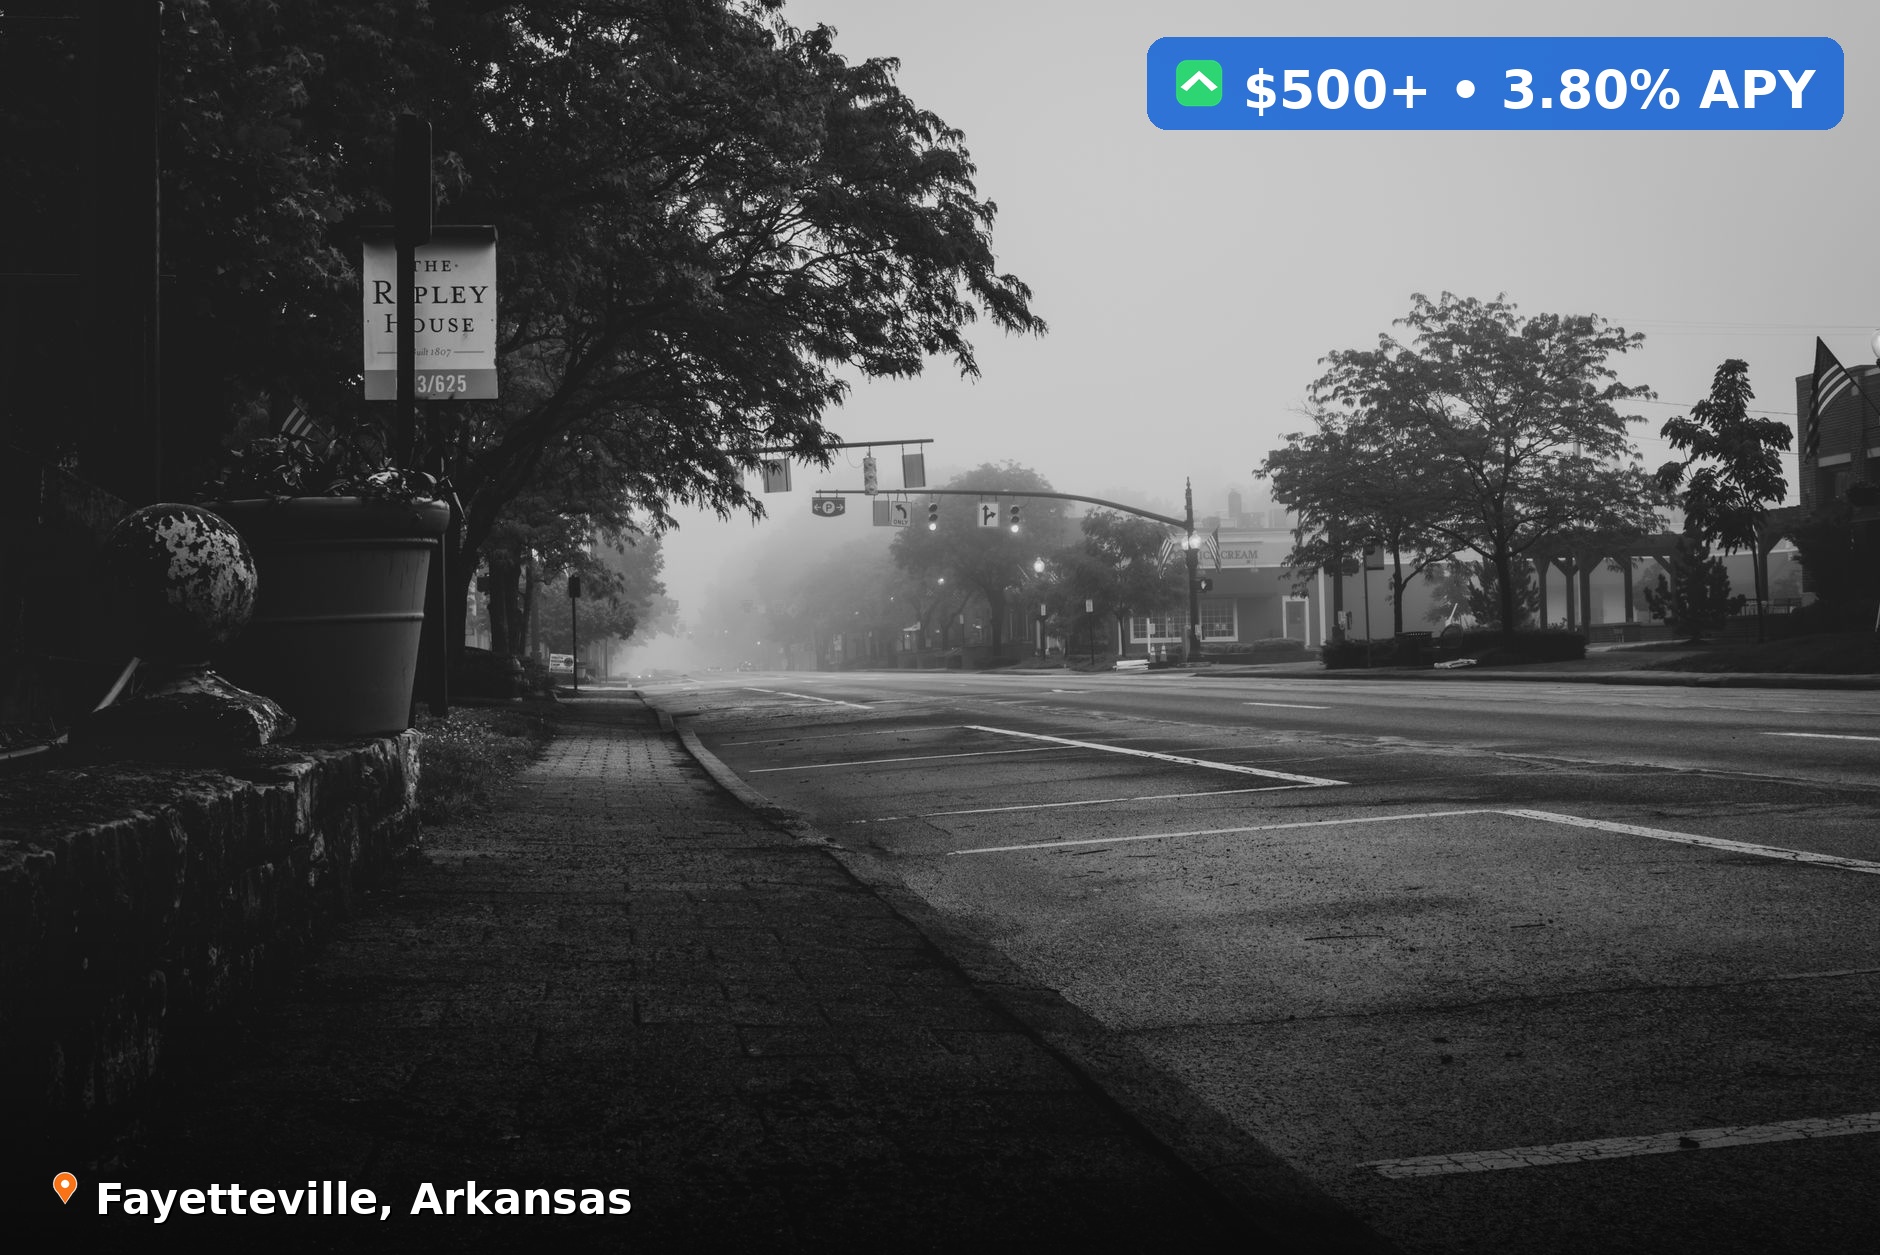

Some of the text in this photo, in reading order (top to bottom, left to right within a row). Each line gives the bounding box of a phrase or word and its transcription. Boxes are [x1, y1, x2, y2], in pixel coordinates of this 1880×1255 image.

[414, 260, 451, 272] THE
[372, 280, 488, 304] RPLEY
[414, 347, 451, 357] uilt 1807
[1221, 550, 1257, 559] CREAM
